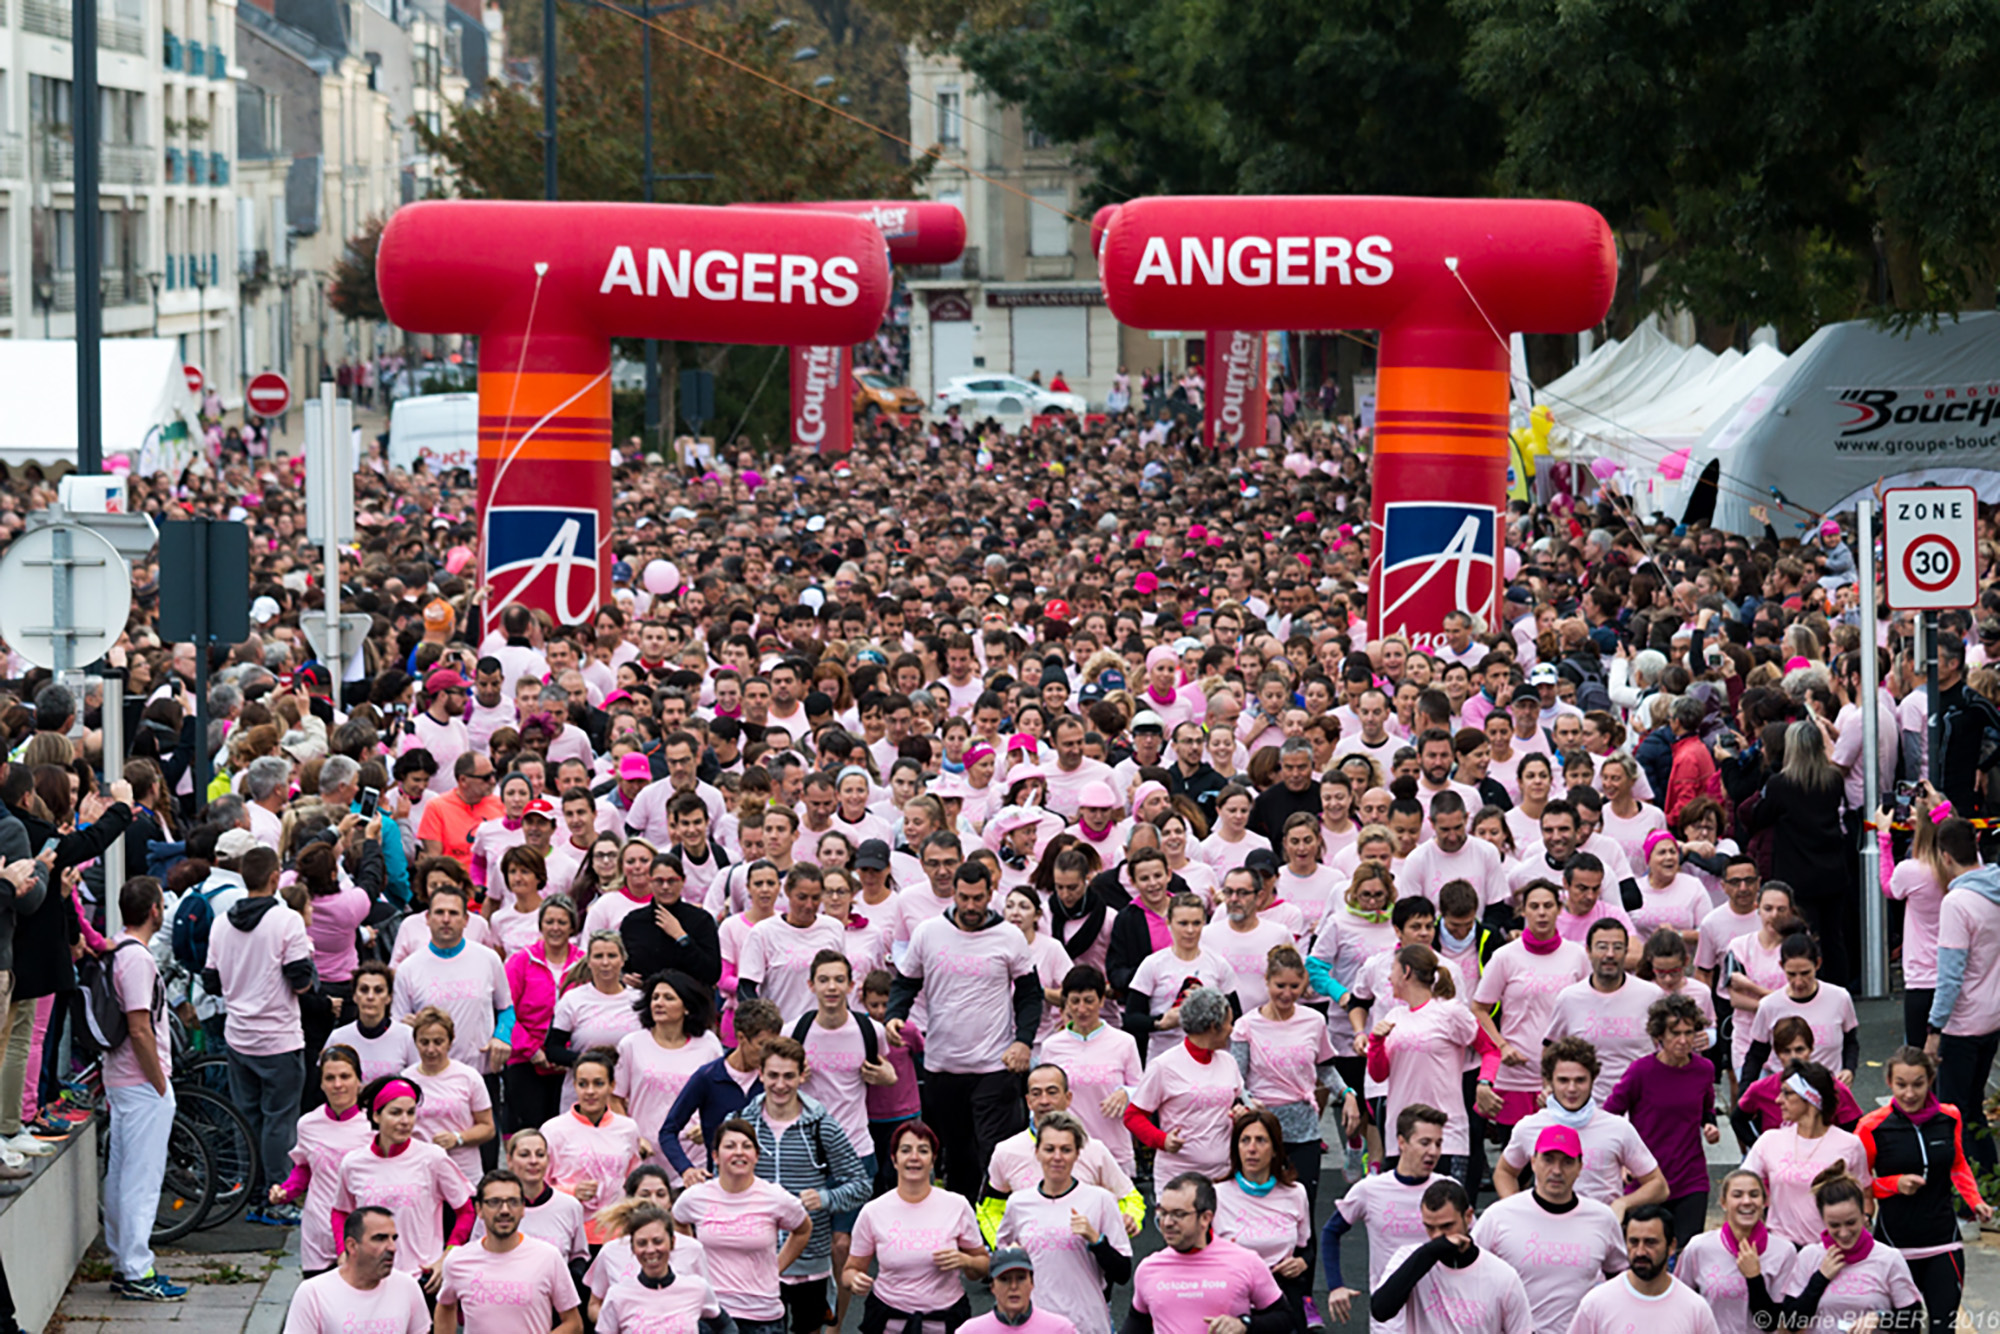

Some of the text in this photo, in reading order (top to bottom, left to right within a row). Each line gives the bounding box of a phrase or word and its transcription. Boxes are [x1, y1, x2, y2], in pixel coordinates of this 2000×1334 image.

[1133, 236, 1394, 286] ANGERS
[600, 246, 859, 307] ANGERS
[1834, 431, 2000, 455] www.groupe-bouc
[1898, 502, 1962, 521] ZONE
[1915, 550, 1949, 575] 30
